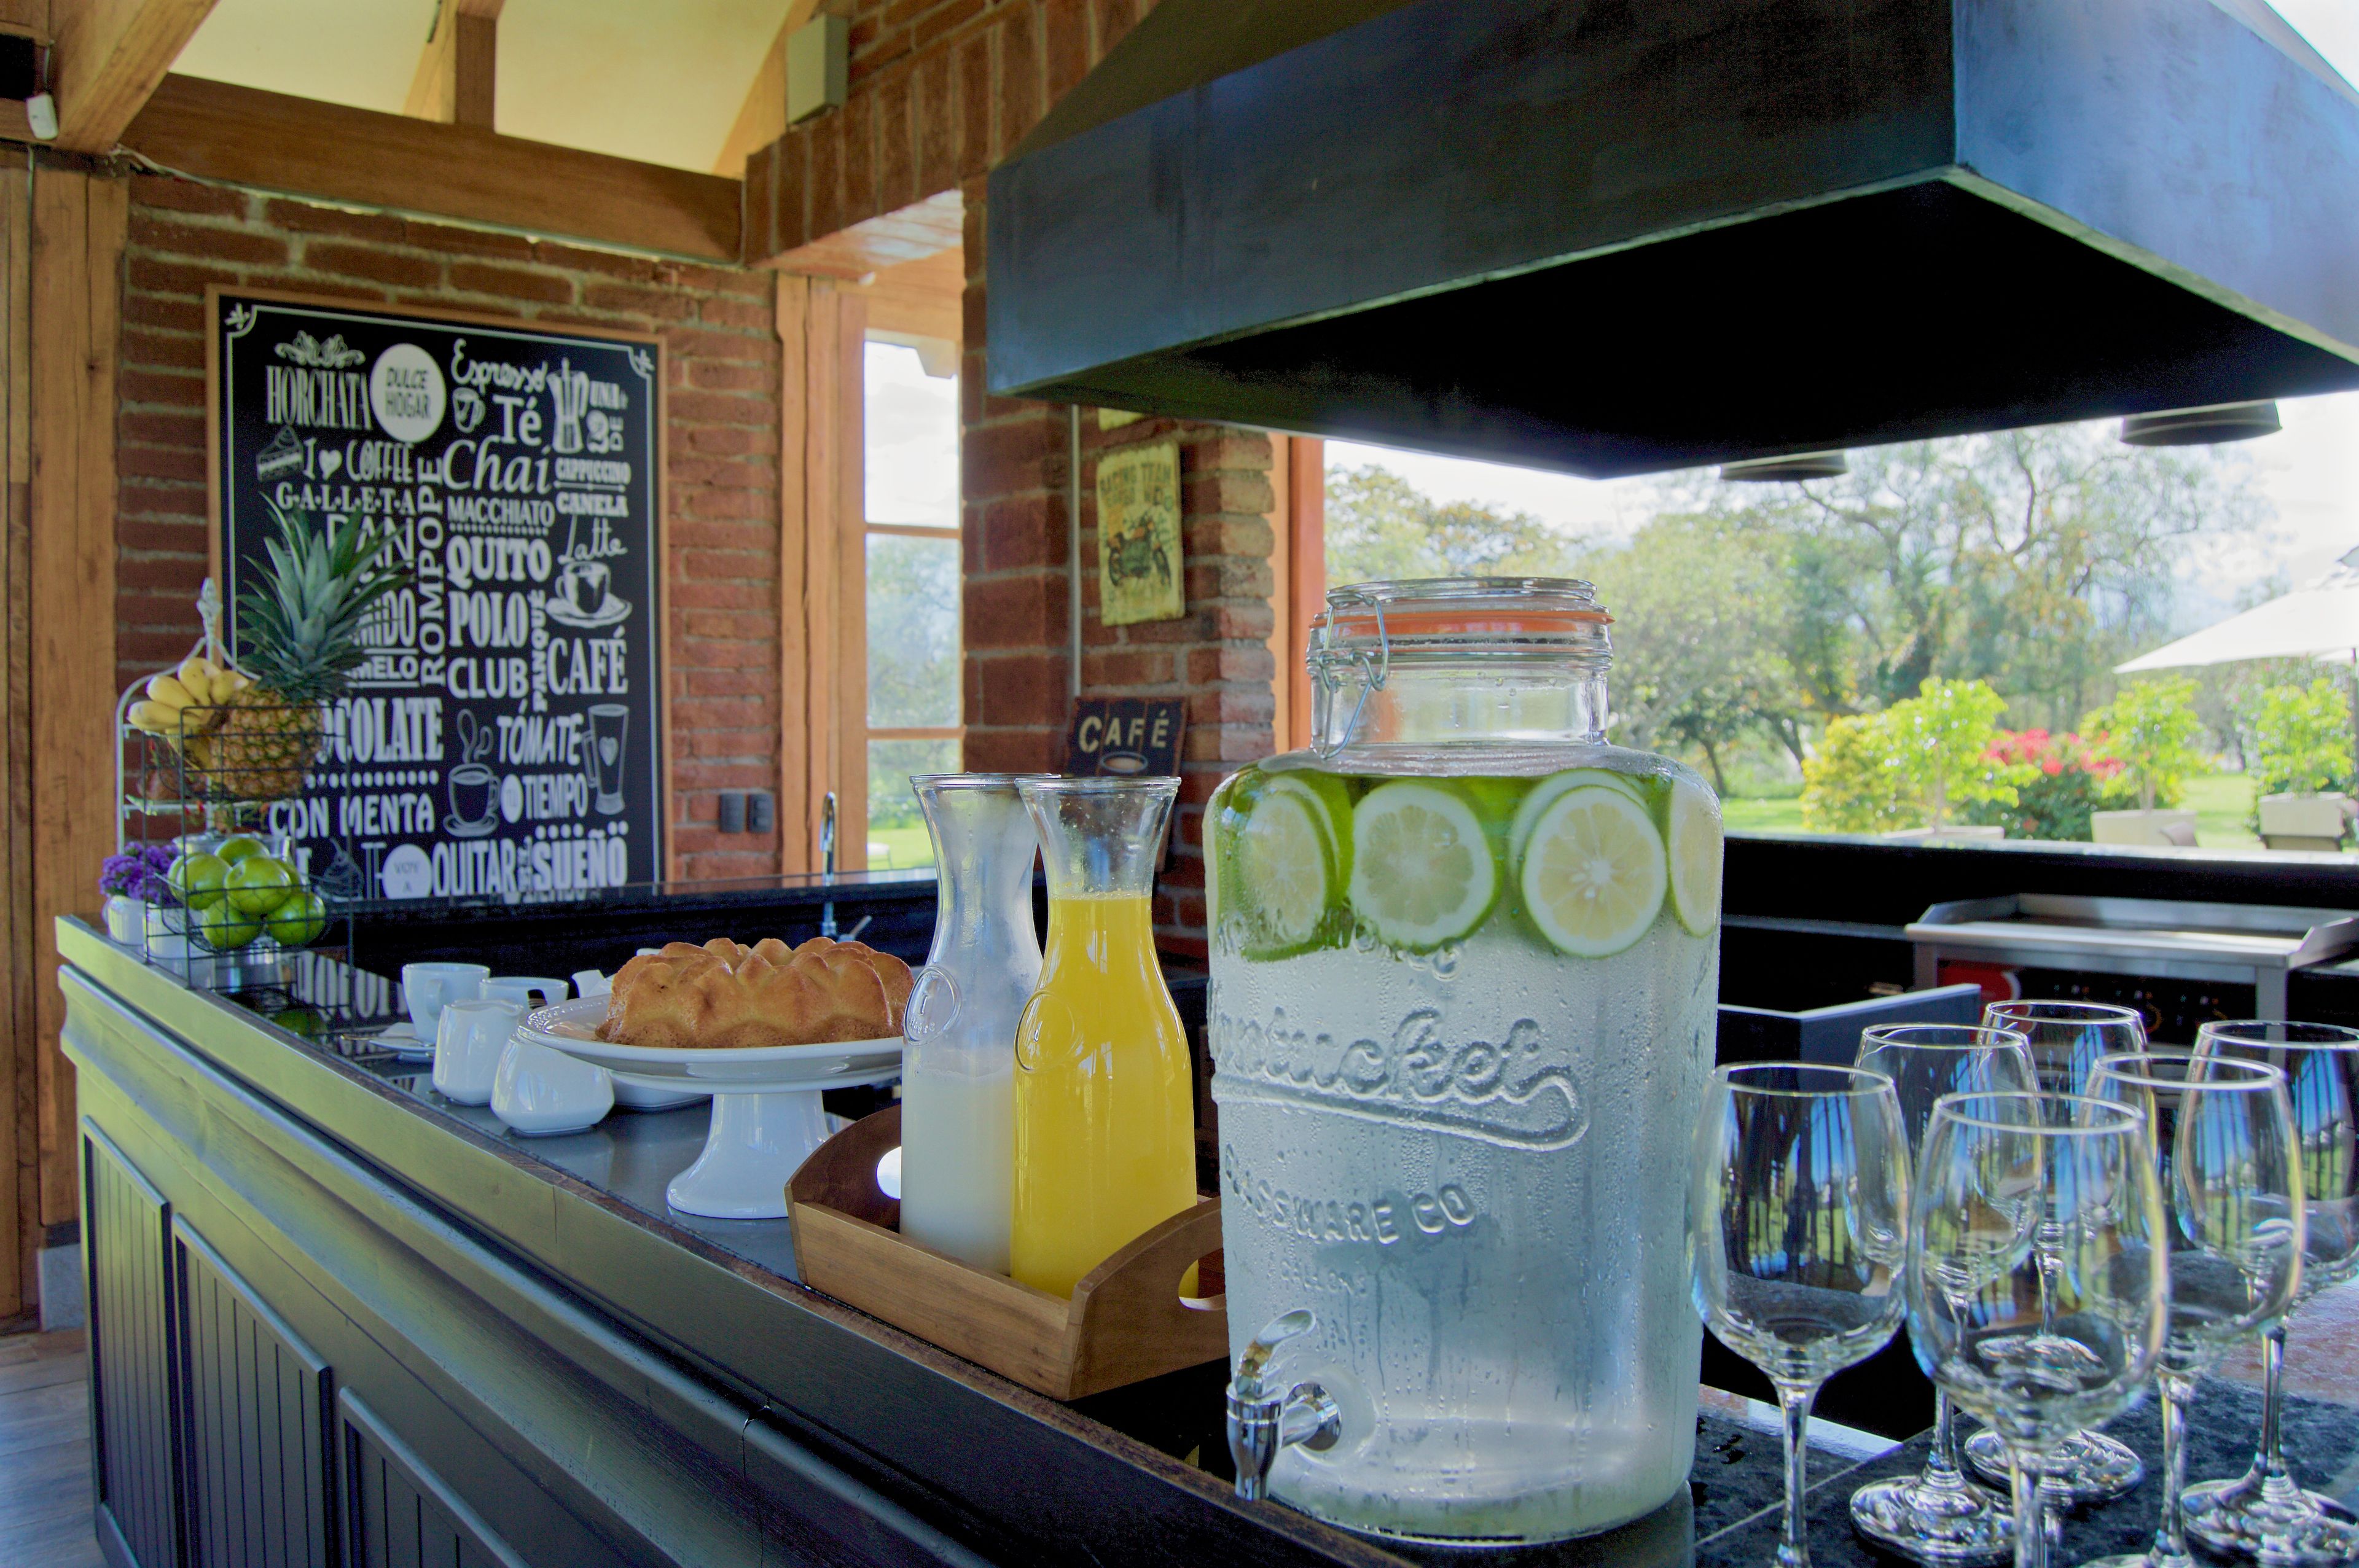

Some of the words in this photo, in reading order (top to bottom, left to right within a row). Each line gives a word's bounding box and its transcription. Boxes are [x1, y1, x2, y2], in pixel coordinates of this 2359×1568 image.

[265, 365, 372, 431] HORCHATA
[492, 394, 542, 447] Té
[346, 439, 415, 483] COFFEE
[442, 434, 552, 495] Chai
[447, 495, 556, 528] MACCHIATO
[555, 491, 630, 518] CANELA
[446, 534, 552, 590] QUITO
[557, 514, 628, 566] Latte
[417, 456, 447, 688] ROMPOPE
[447, 590, 530, 649] POLO
[447, 657, 530, 700] CLUB
[547, 624, 630, 696] CAFÉ
[1078, 711, 1170, 754] CAFÉ
[268, 798, 330, 840] CON
[338, 792, 436, 837] MENTA
[522, 772, 589, 820] TIEMPO
[532, 829, 628, 891] SUEÑO
